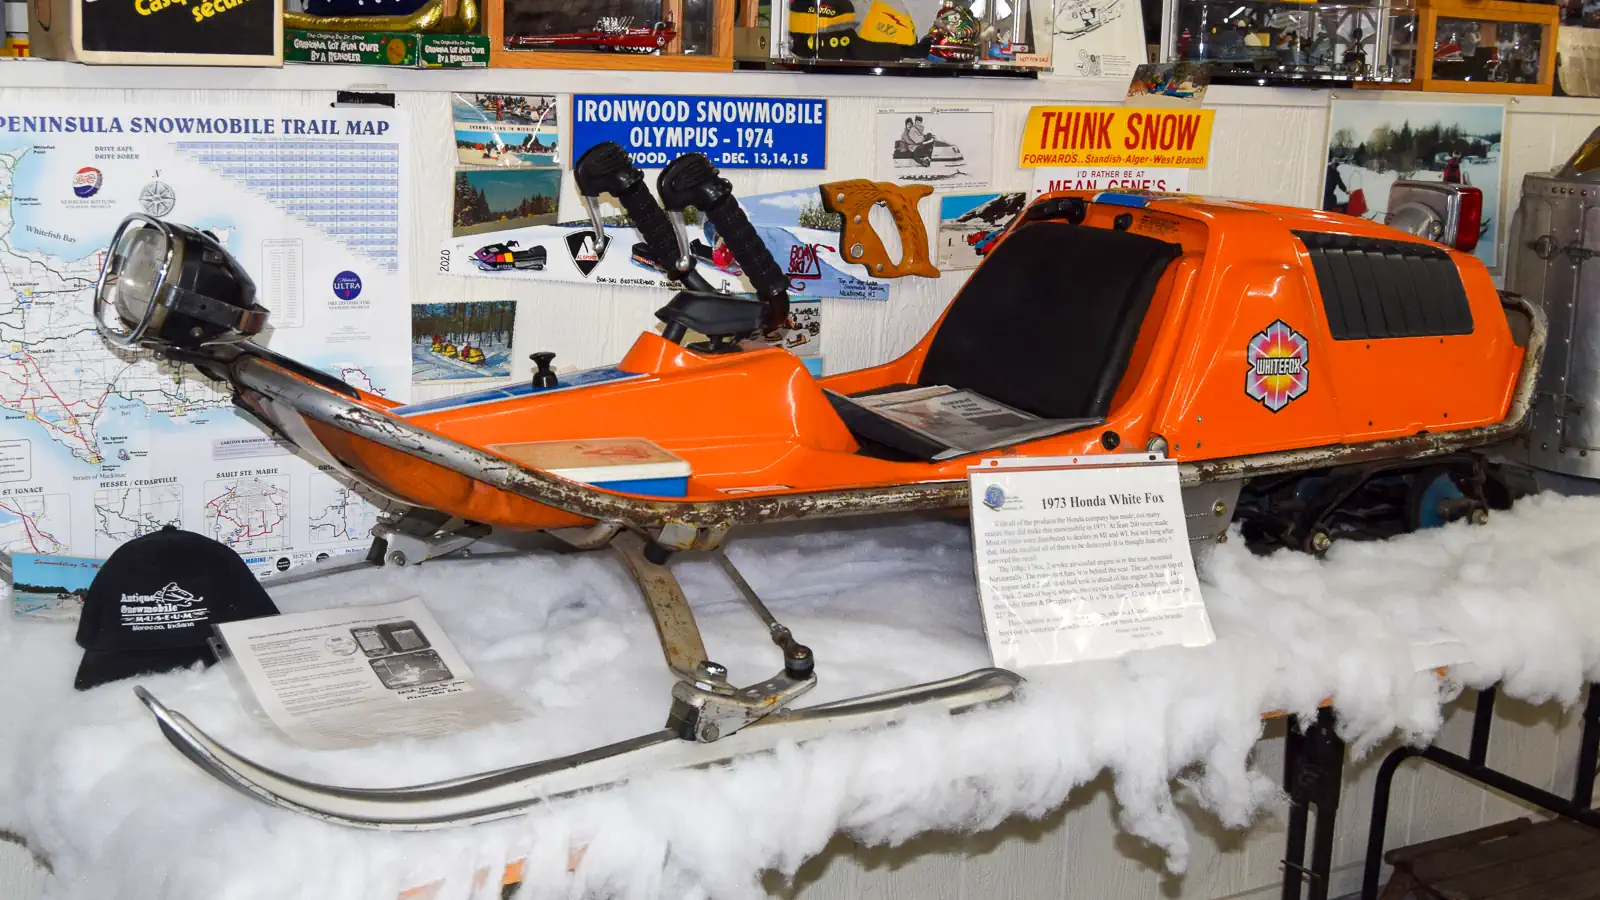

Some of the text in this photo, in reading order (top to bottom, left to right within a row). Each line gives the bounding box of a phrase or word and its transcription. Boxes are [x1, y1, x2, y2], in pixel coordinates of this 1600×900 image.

[577, 100, 823, 125] IRONWOOD SNOWMOBILE
[131, 117, 275, 135] SNOWMOBILE
[282, 119, 339, 136] TRAIL
[346, 120, 390, 136] MAP
[1040, 112, 1202, 151] THINK SNOW
[629, 126, 718, 149] OLYMPUS
[736, 127, 774, 149] 1974
[722, 152, 749, 164] DEC.
[754, 153, 809, 165] 13,14,15
[1176, 156, 1205, 165] Branch
[26, 225, 77, 244] Whitefish Bay
[440, 249, 450, 272] 2020
[334, 282, 360, 290] ULTRA
[1256, 358, 1301, 375] WHITEFOX
[100, 477, 178, 488] HESSEL CEDARVILLE
[1042, 492, 1165, 509] 1973 Honda White Fox
[120, 593, 155, 603] Antique
[121, 603, 178, 613] Snowmobile
